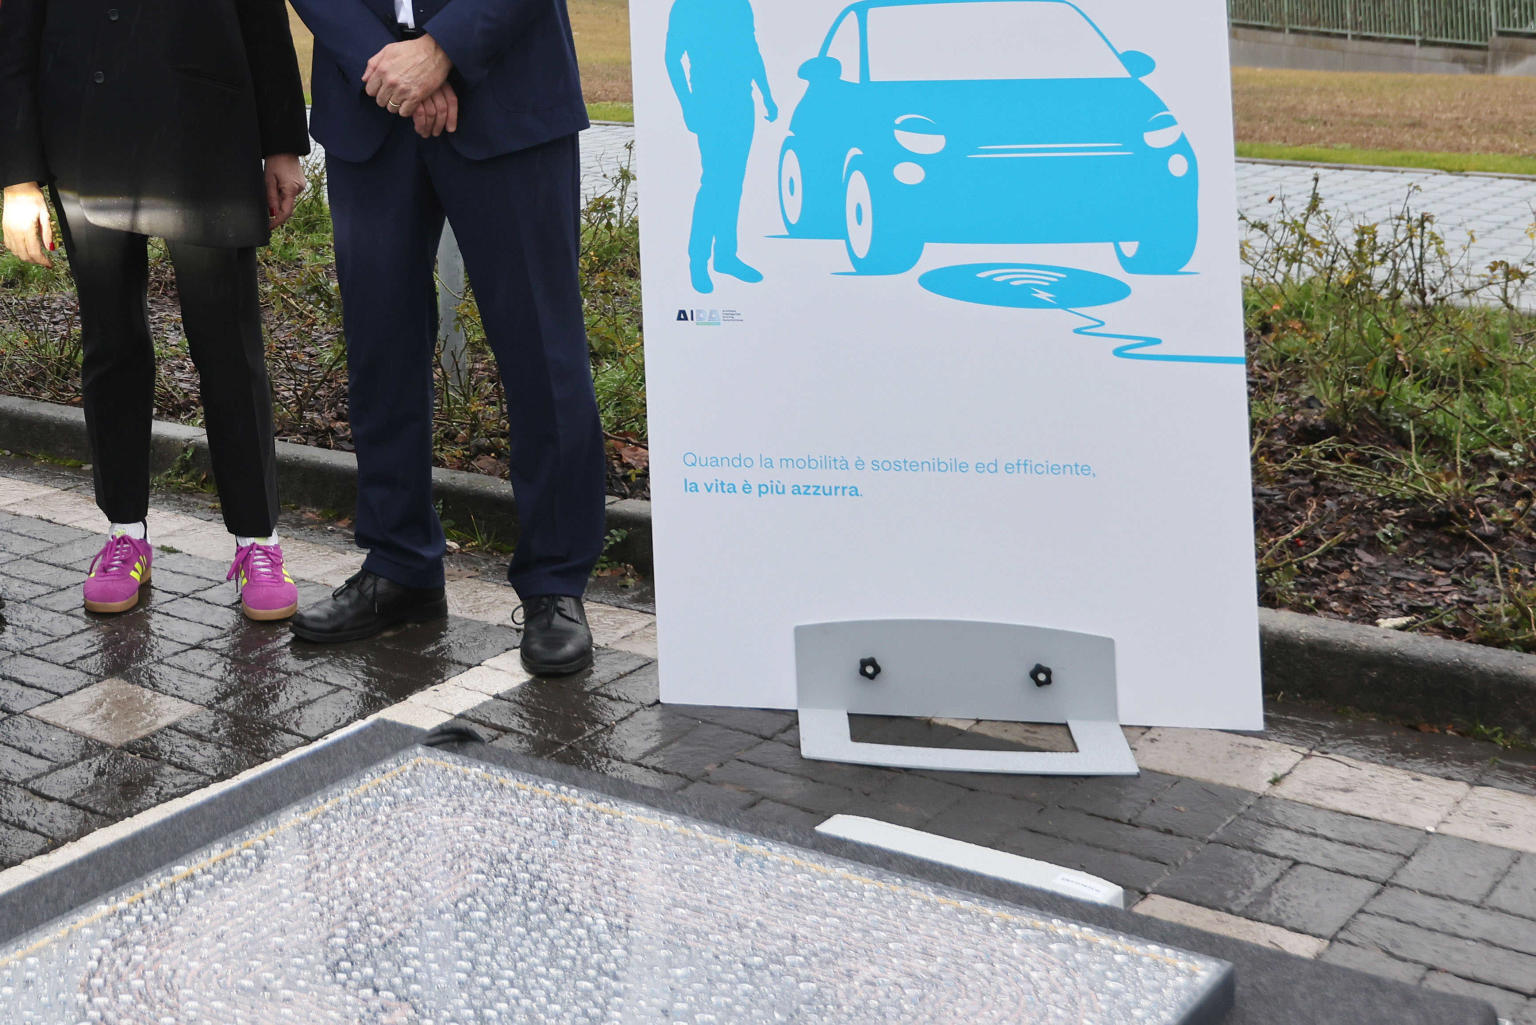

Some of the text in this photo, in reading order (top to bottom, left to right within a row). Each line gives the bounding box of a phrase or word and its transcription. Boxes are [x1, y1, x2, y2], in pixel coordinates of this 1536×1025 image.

[676, 309, 720, 321] AIDA
[683, 452, 1096, 477] Quando la mobilità è sostenibile ed efficiente,
[684, 478, 862, 498] la vita è più azzurra.
